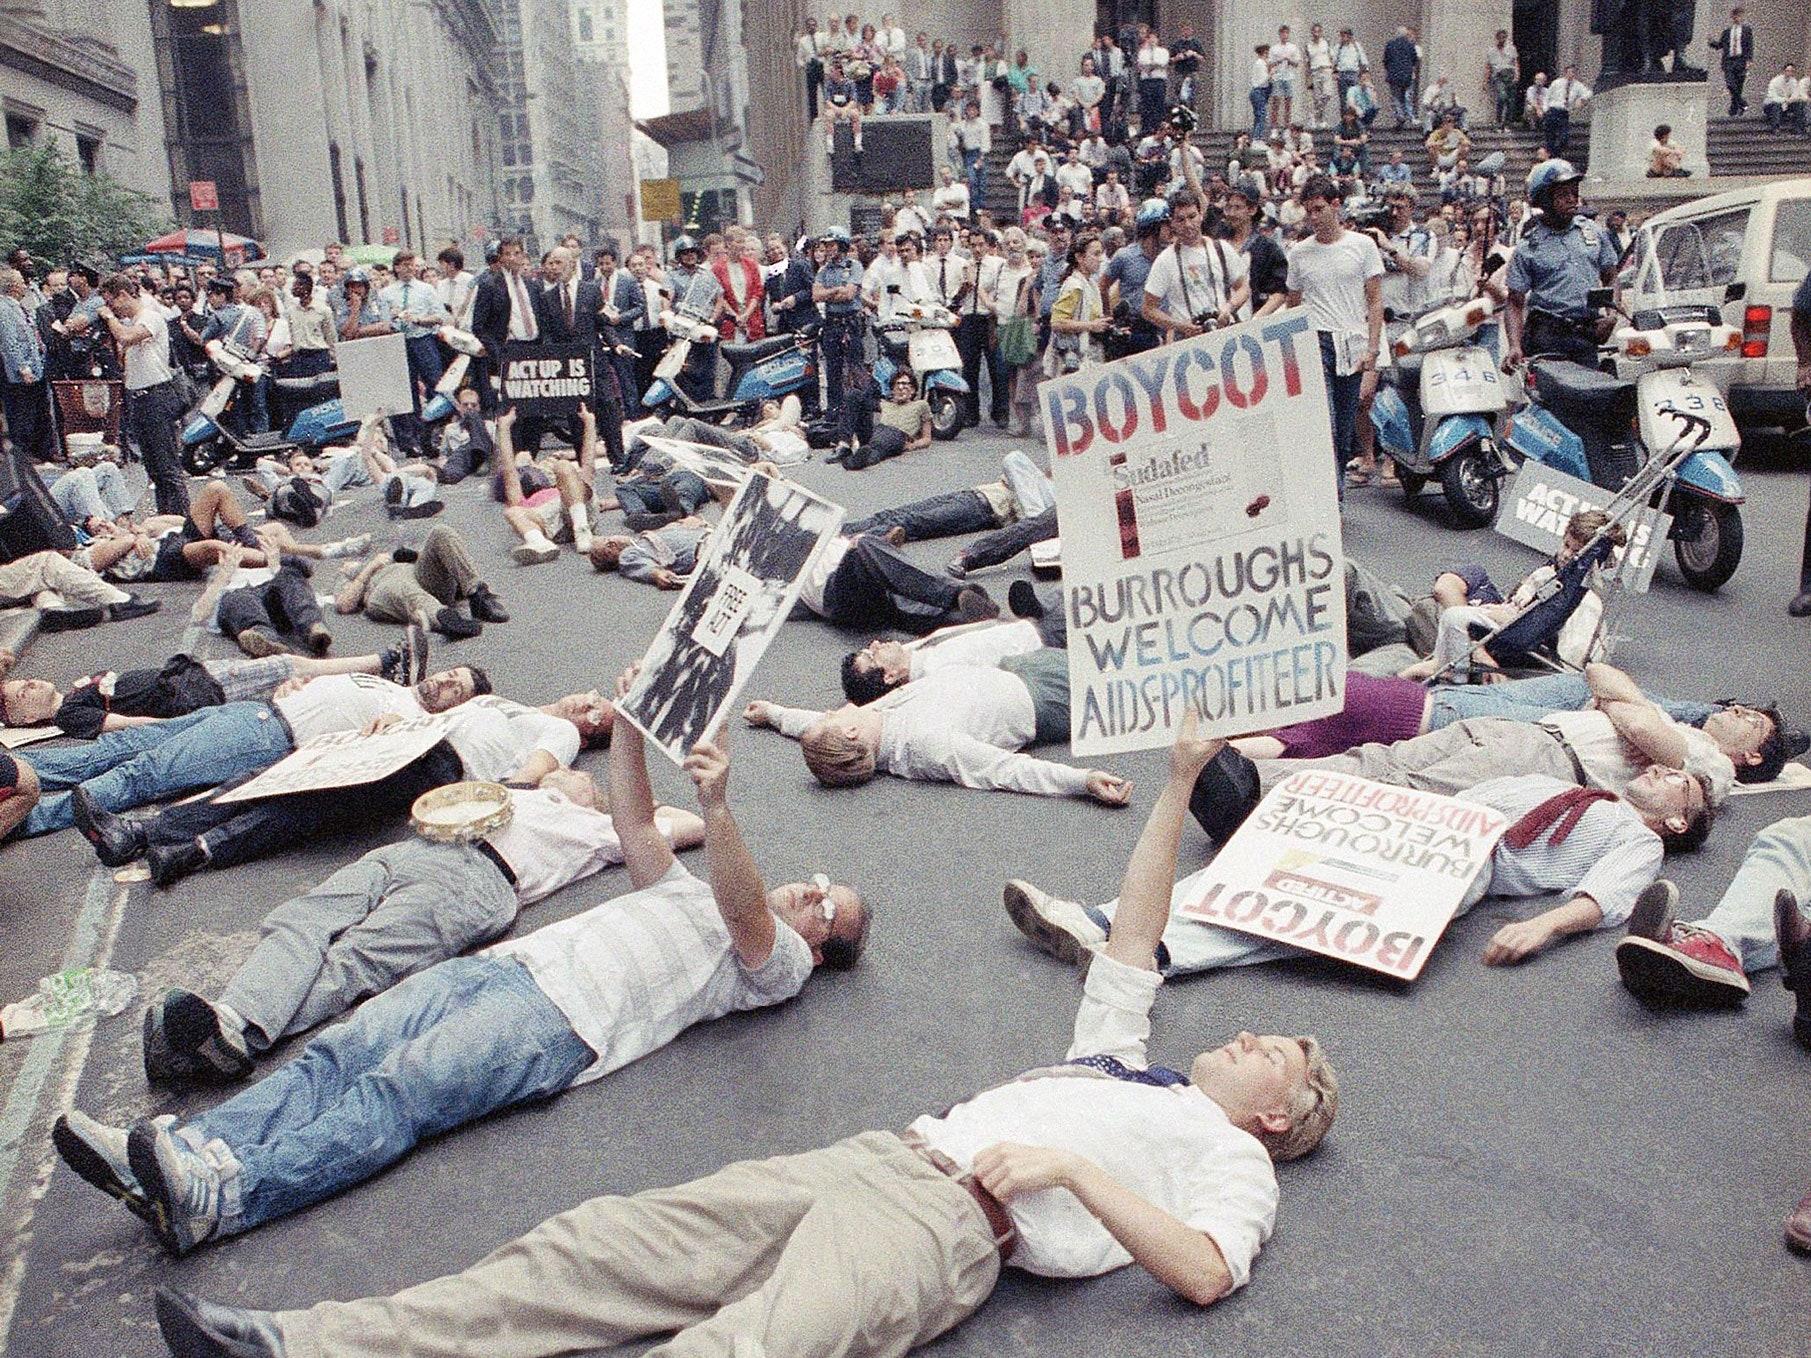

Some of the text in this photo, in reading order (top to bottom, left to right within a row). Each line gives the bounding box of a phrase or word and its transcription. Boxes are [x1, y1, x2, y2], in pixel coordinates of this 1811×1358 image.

[505, 378, 590, 398] WATCHING
[509, 358, 586, 379] ACT UP IS
[1049, 317, 1307, 456] BOYCOT
[1112, 442, 1211, 488] Sudafed
[1526, 482, 1579, 519] ACT
[1071, 533, 1334, 629] BURROUGHS
[1085, 583, 1333, 673] WELCOME
[1256, 812, 1475, 880] BURROUGHS
[1275, 796, 1473, 859] WELCOME
[1184, 882, 1426, 972] BOYCOT
